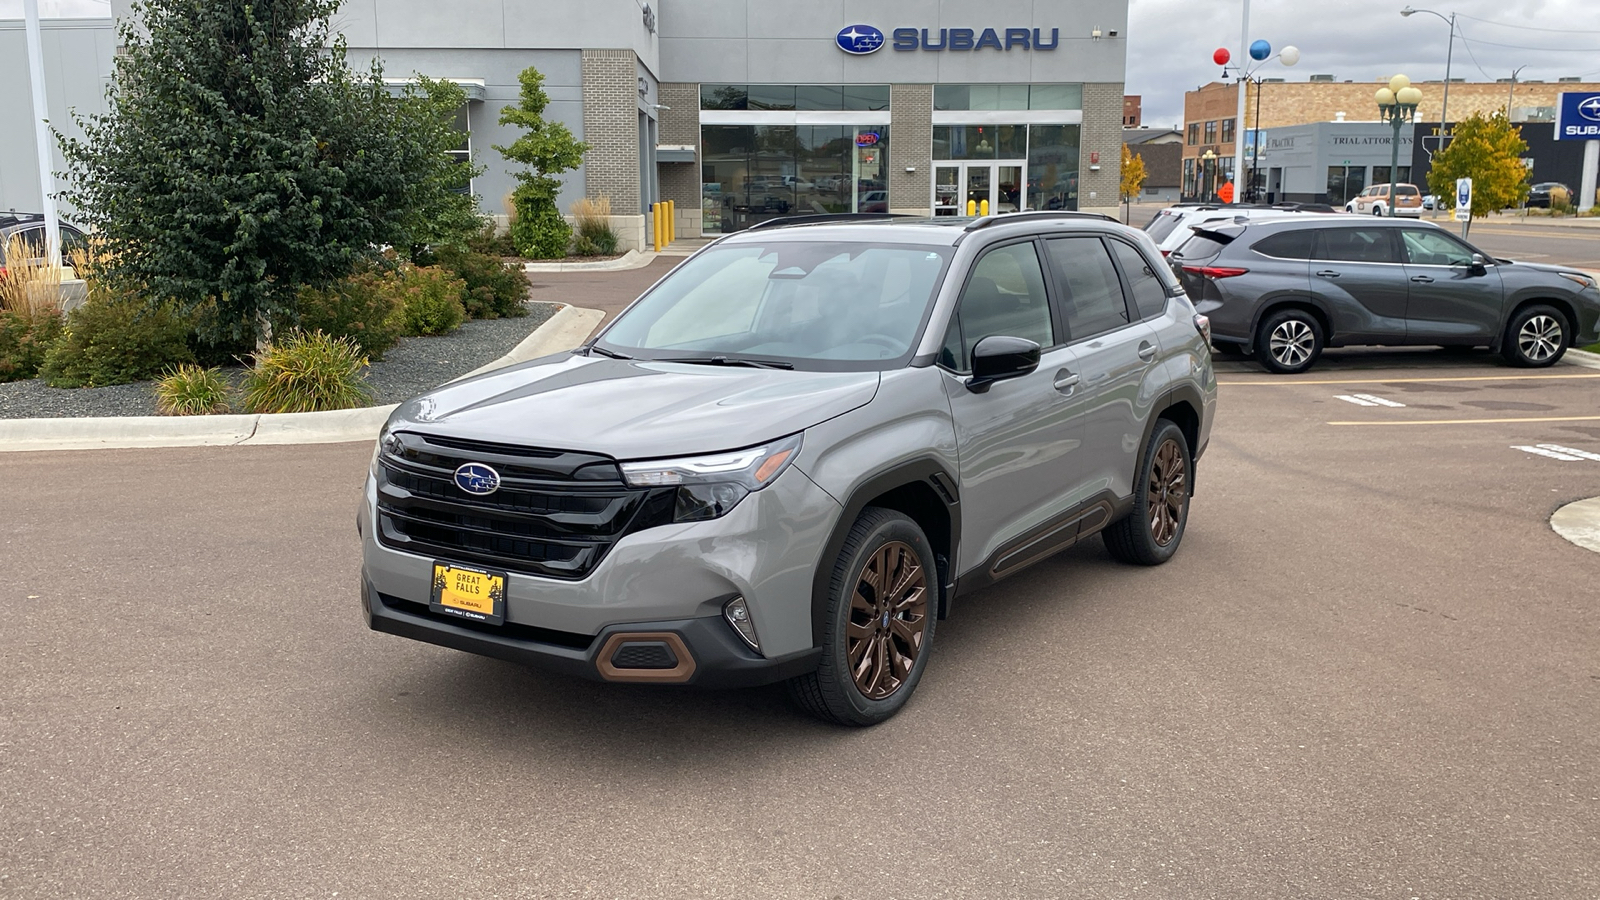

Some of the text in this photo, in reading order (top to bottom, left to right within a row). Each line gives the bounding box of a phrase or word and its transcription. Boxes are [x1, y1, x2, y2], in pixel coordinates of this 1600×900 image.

[893, 28, 1059, 51] SUBARU
[1566, 126, 1600, 135] SUB
[856, 134, 877, 144] OPEN
[1333, 137, 1360, 145] TRIAL
[456, 573, 480, 585] GREAT
[456, 582, 480, 594] FALLS
[460, 600, 482, 608] SUBARU
